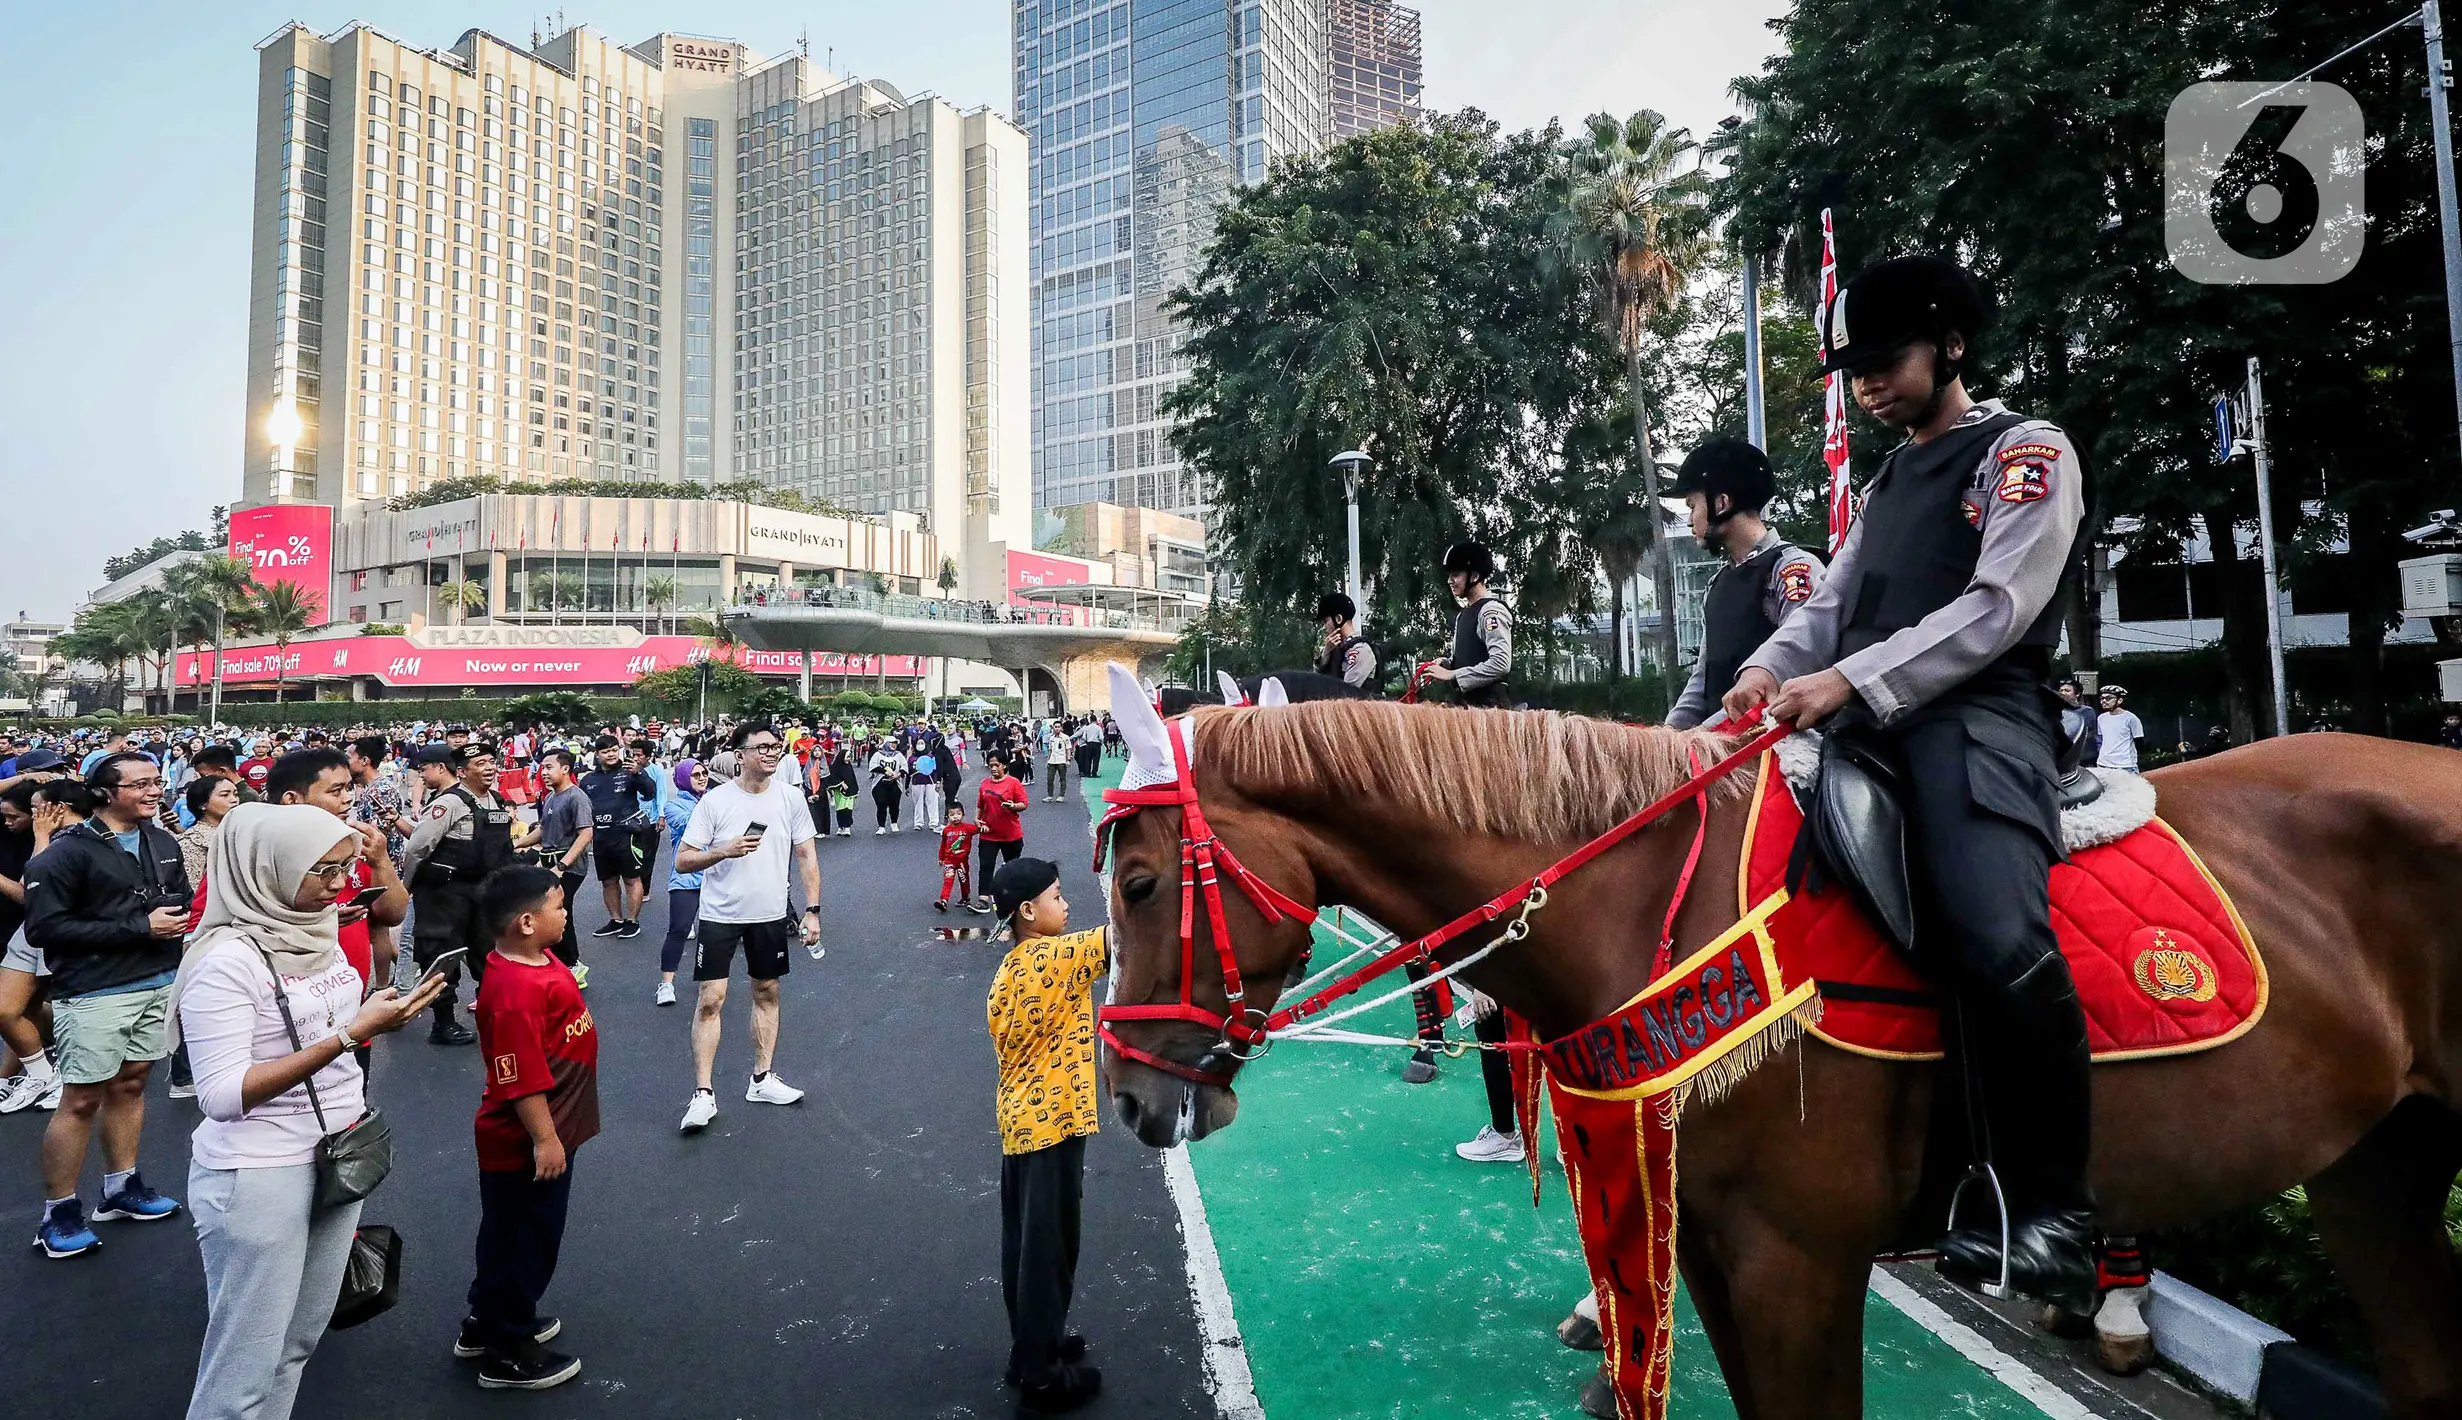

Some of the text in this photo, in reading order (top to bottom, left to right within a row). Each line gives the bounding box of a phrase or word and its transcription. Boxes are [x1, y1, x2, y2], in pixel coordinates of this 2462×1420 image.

[673, 44, 729, 58] GRAND
[674, 59, 728, 73] HYATT
[409, 526, 440, 542] GRAD
[750, 526, 845, 548] GRAND HYATT
[235, 539, 254, 554] Final
[1021, 570, 1043, 585] Final
[428, 629, 622, 645] PLAZA INDONESIA
[221, 657, 242, 674] Final
[244, 656, 262, 673] sale
[285, 653, 300, 670] off
[333, 649, 348, 668] H&M
[387, 657, 421, 677] H&M
[465, 659, 581, 673] Now or never
[625, 656, 656, 674] H&M
[745, 650, 784, 666] Final
[788, 655, 816, 668] sae
[309, 970, 356, 998] COMES
[1552, 949, 1762, 1089] TURANGGA
[296, 1030, 321, 1043] 2.00
